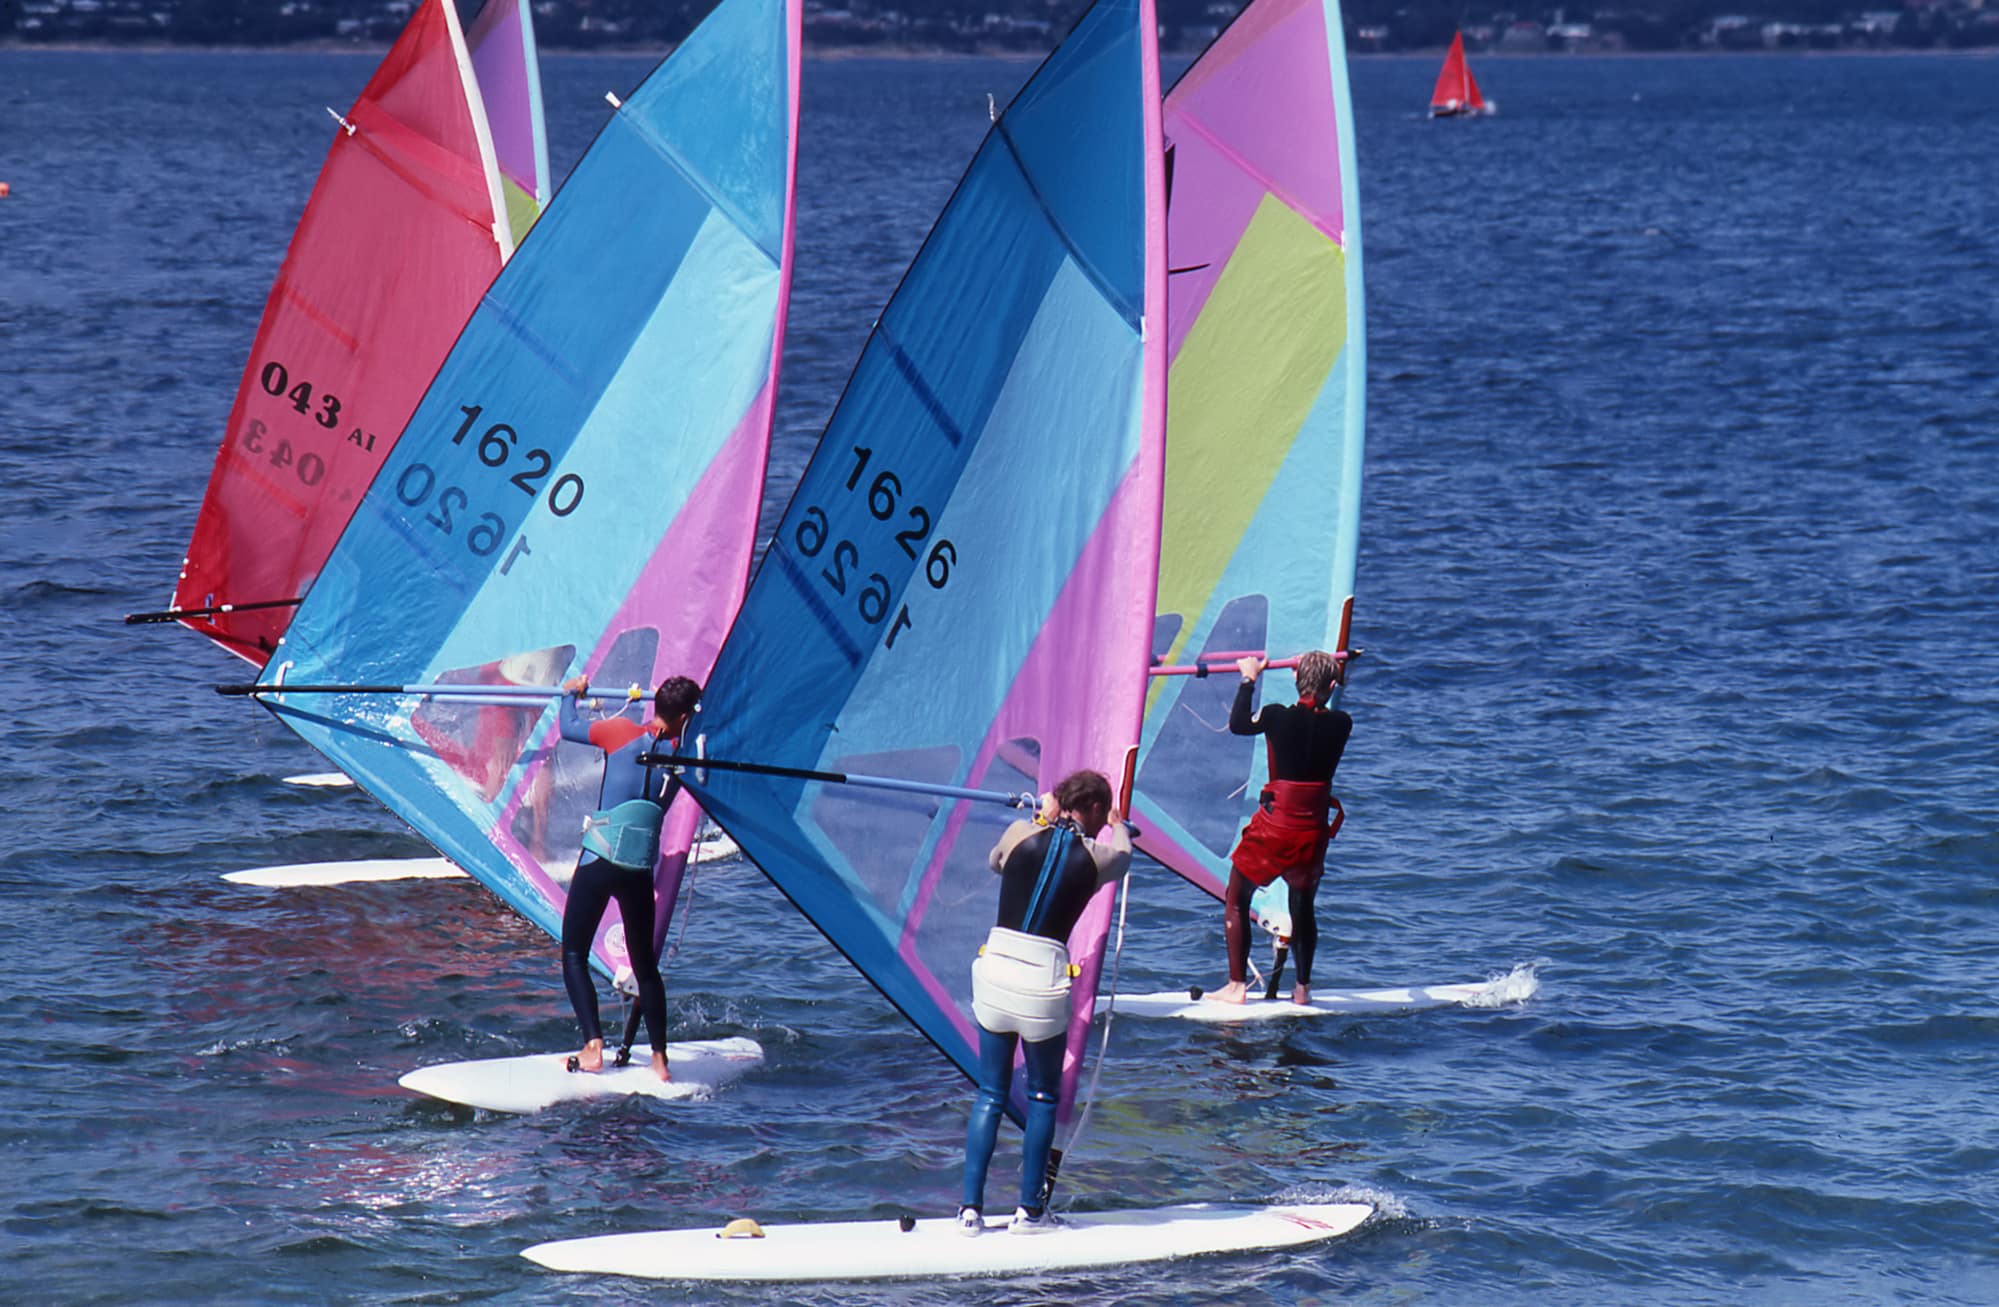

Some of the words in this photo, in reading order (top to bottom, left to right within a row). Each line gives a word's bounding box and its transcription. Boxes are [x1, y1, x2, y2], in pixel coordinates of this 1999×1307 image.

[261, 361, 342, 430] 043
[451, 404, 585, 517] 1620
[846, 445, 957, 589] 1626
